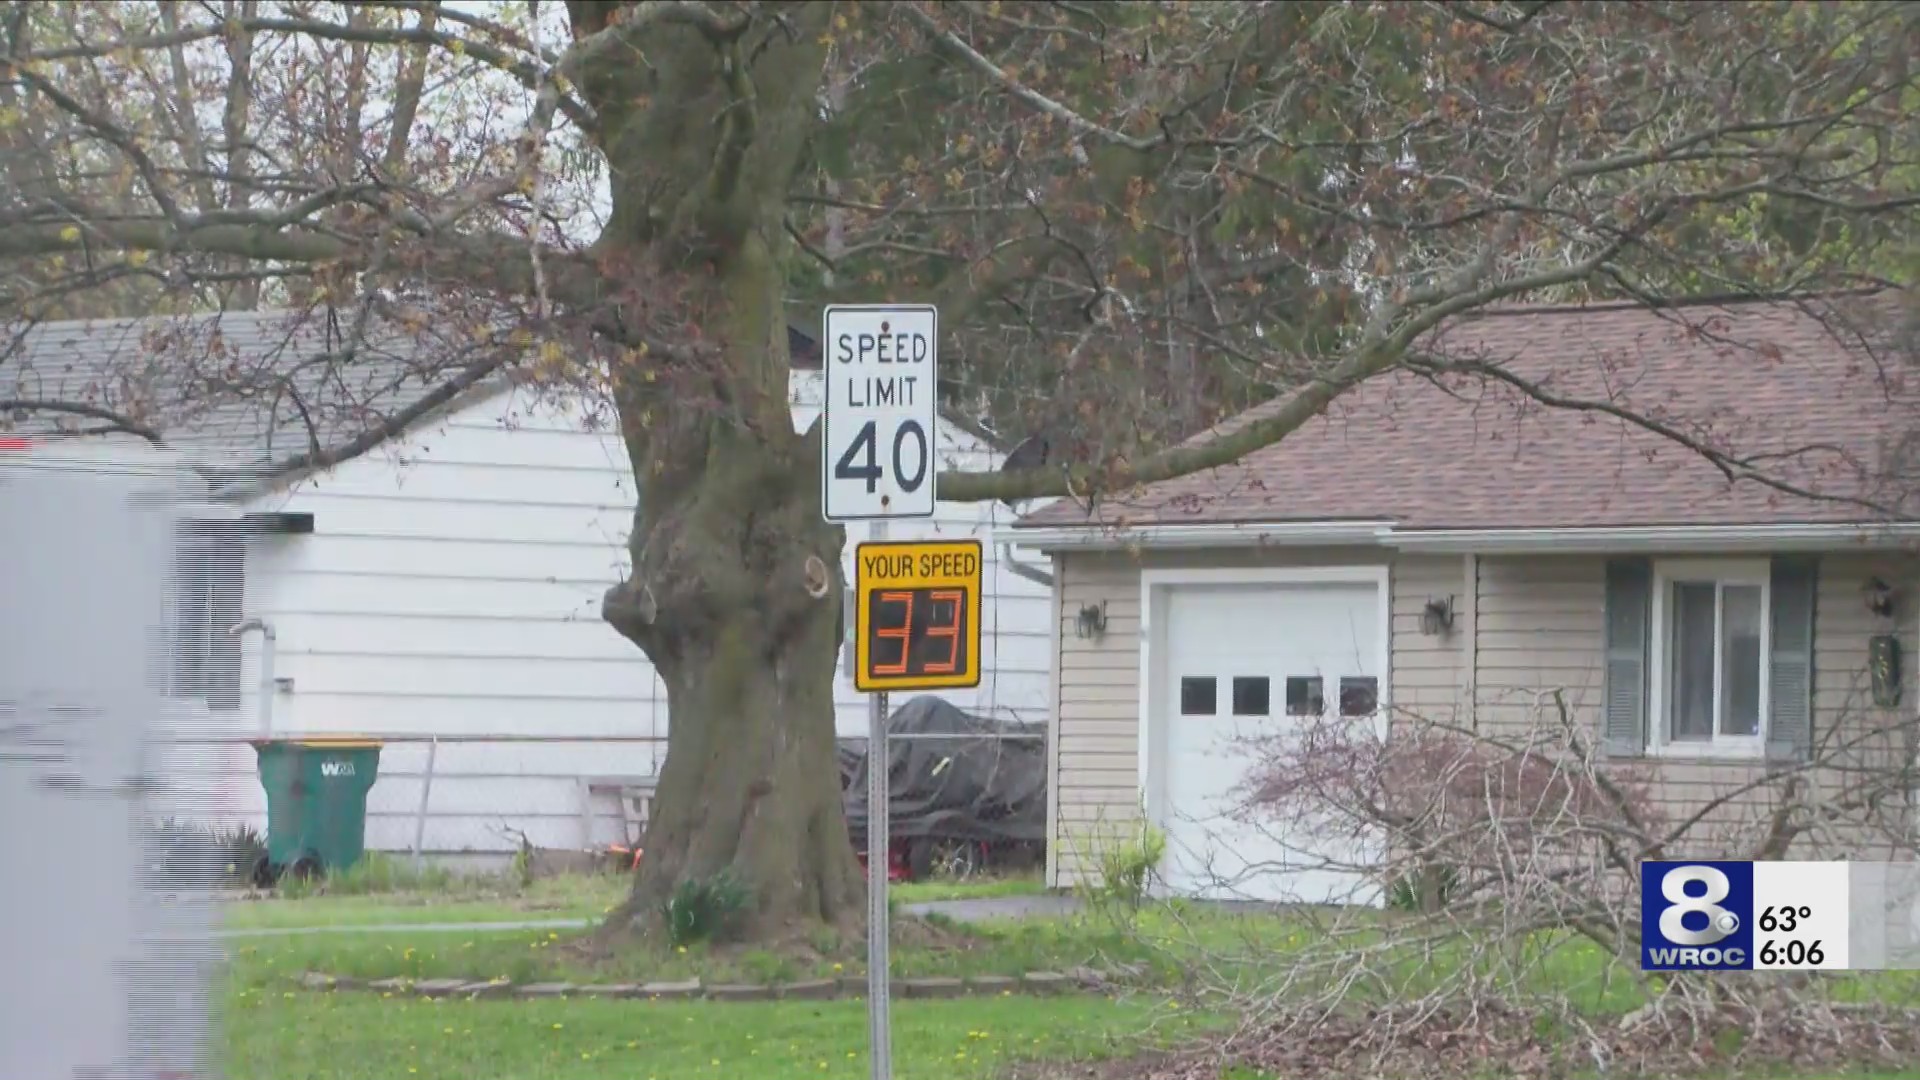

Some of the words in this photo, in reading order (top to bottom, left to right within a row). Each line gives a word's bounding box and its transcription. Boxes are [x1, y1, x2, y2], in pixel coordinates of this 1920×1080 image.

[838, 333, 926, 363] SPEED
[848, 376, 917, 406] LIMIT
[834, 420, 928, 493] 40
[864, 554, 914, 578] YOUR
[919, 553, 976, 577] SPEED
[873, 591, 962, 674] 33
